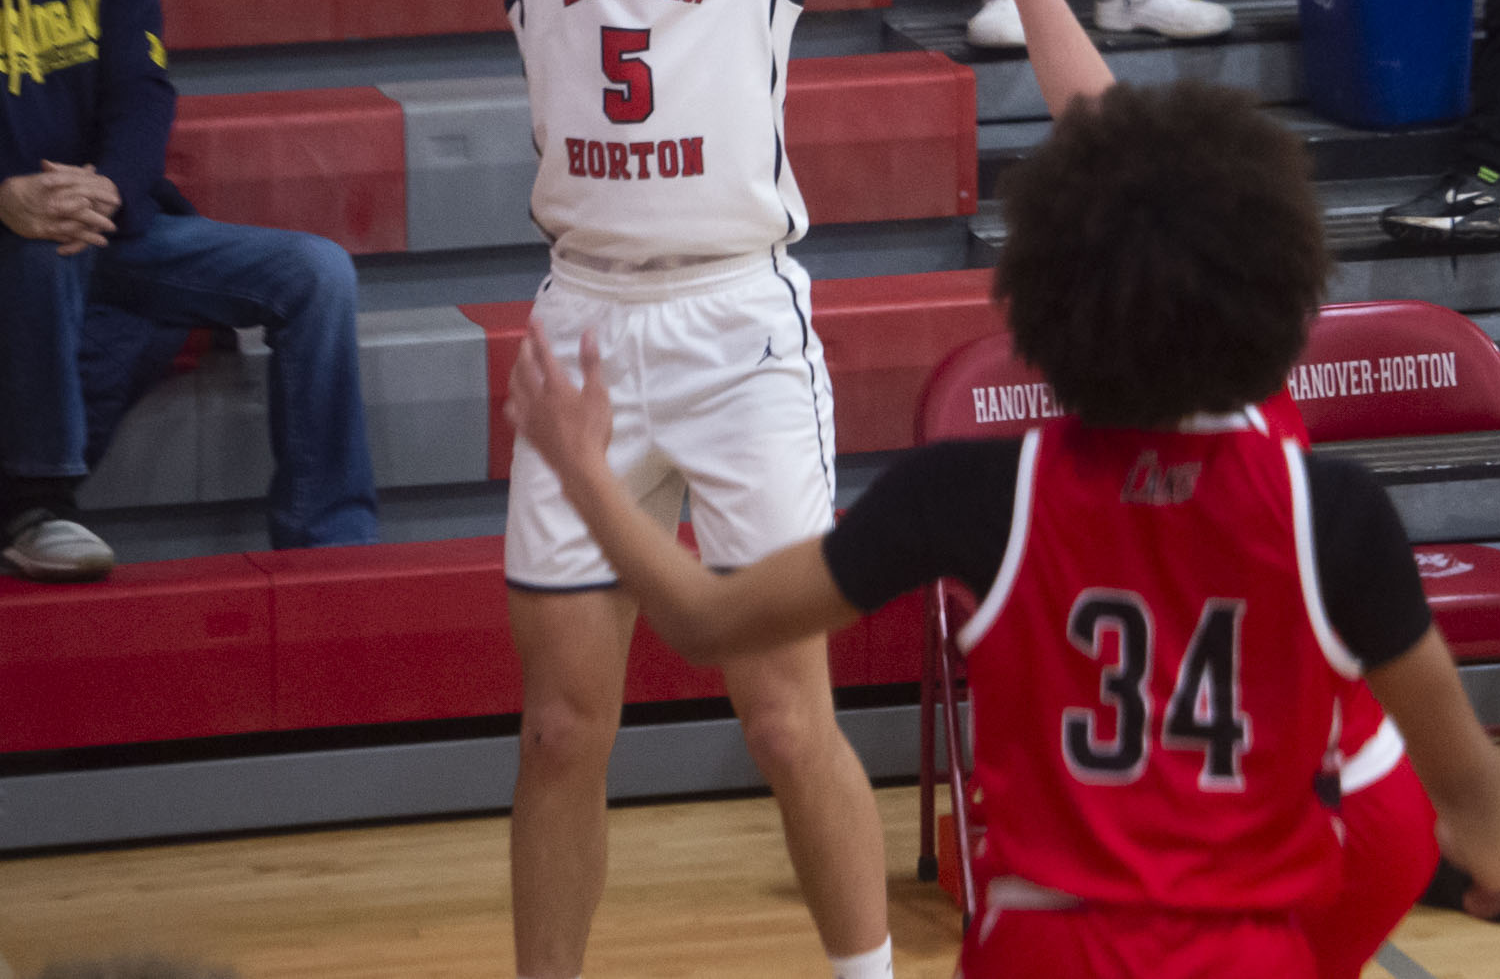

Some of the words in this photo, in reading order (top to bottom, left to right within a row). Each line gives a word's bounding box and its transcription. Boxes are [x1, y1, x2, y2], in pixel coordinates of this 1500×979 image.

[600, 25, 654, 124] 5
[566, 136, 705, 180] HORTON
[1061, 586, 1254, 794] 34
